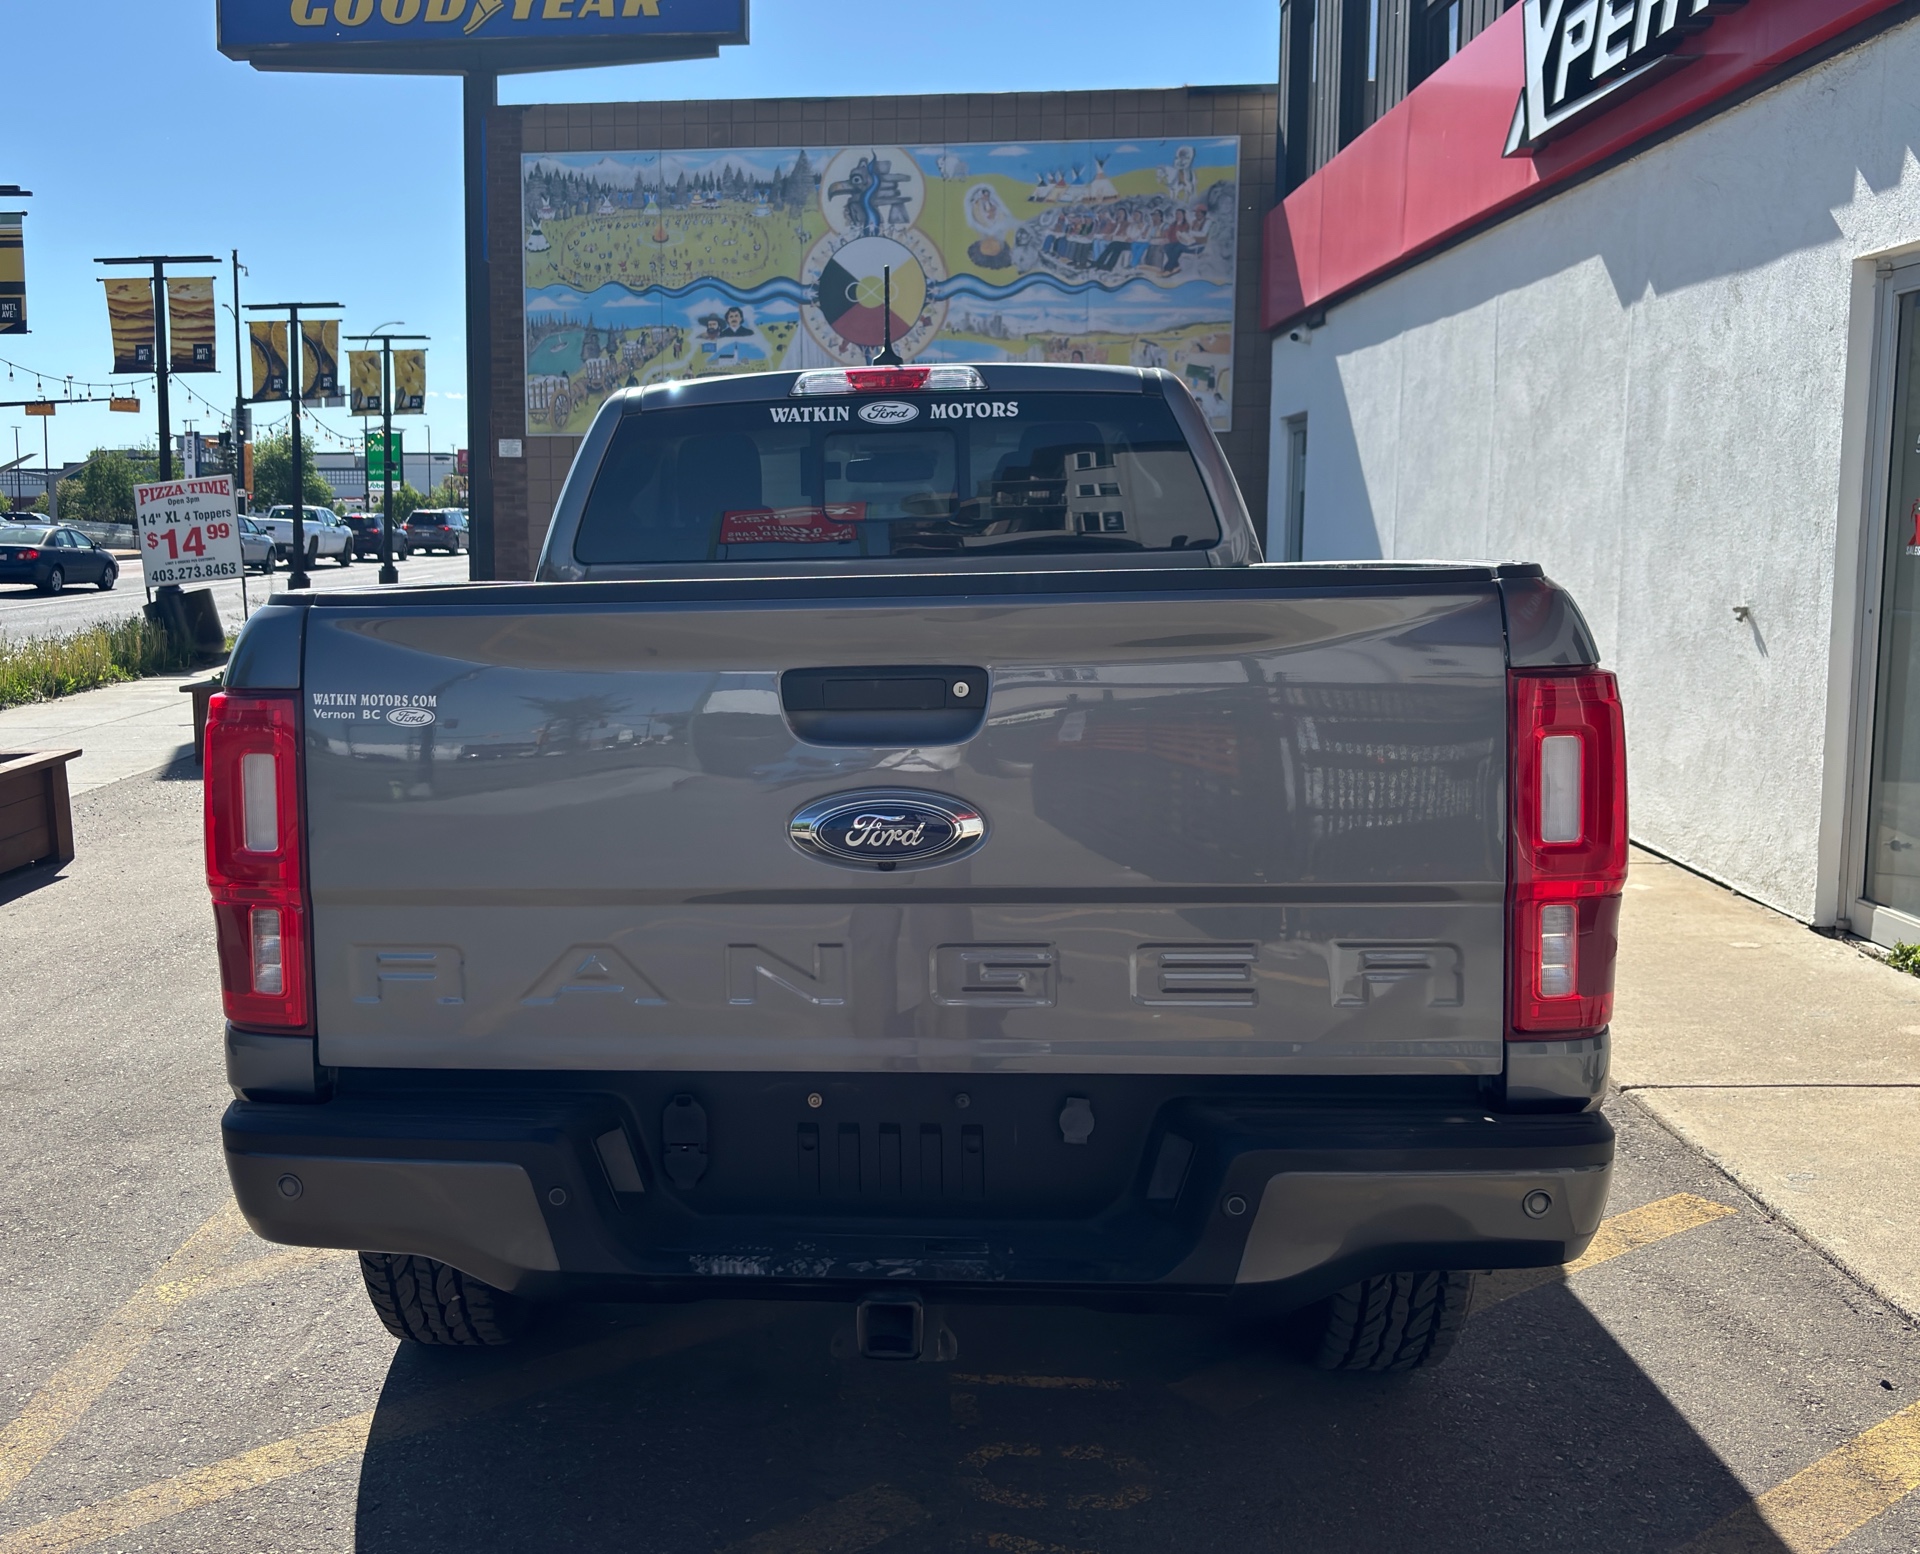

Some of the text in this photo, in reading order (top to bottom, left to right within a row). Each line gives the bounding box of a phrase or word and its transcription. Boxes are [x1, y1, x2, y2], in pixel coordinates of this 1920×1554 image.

[2, 310, 14, 318] AVE
[769, 401, 1019, 423] WATKIN Ford MOTORS
[138, 480, 230, 506] PIZZA TIME
[168, 496, 200, 506] Open 3pm
[141, 509, 231, 526] 14" XL 4 Toppers
[152, 562, 236, 582] 403.273.8463
[313, 694, 437, 707] WATKIN MOTORS.COM
[313, 709, 355, 719] Vernon
[362, 710, 380, 719] BC
[845, 813, 926, 846] Ford
[350, 939, 1464, 1009] RANGER
